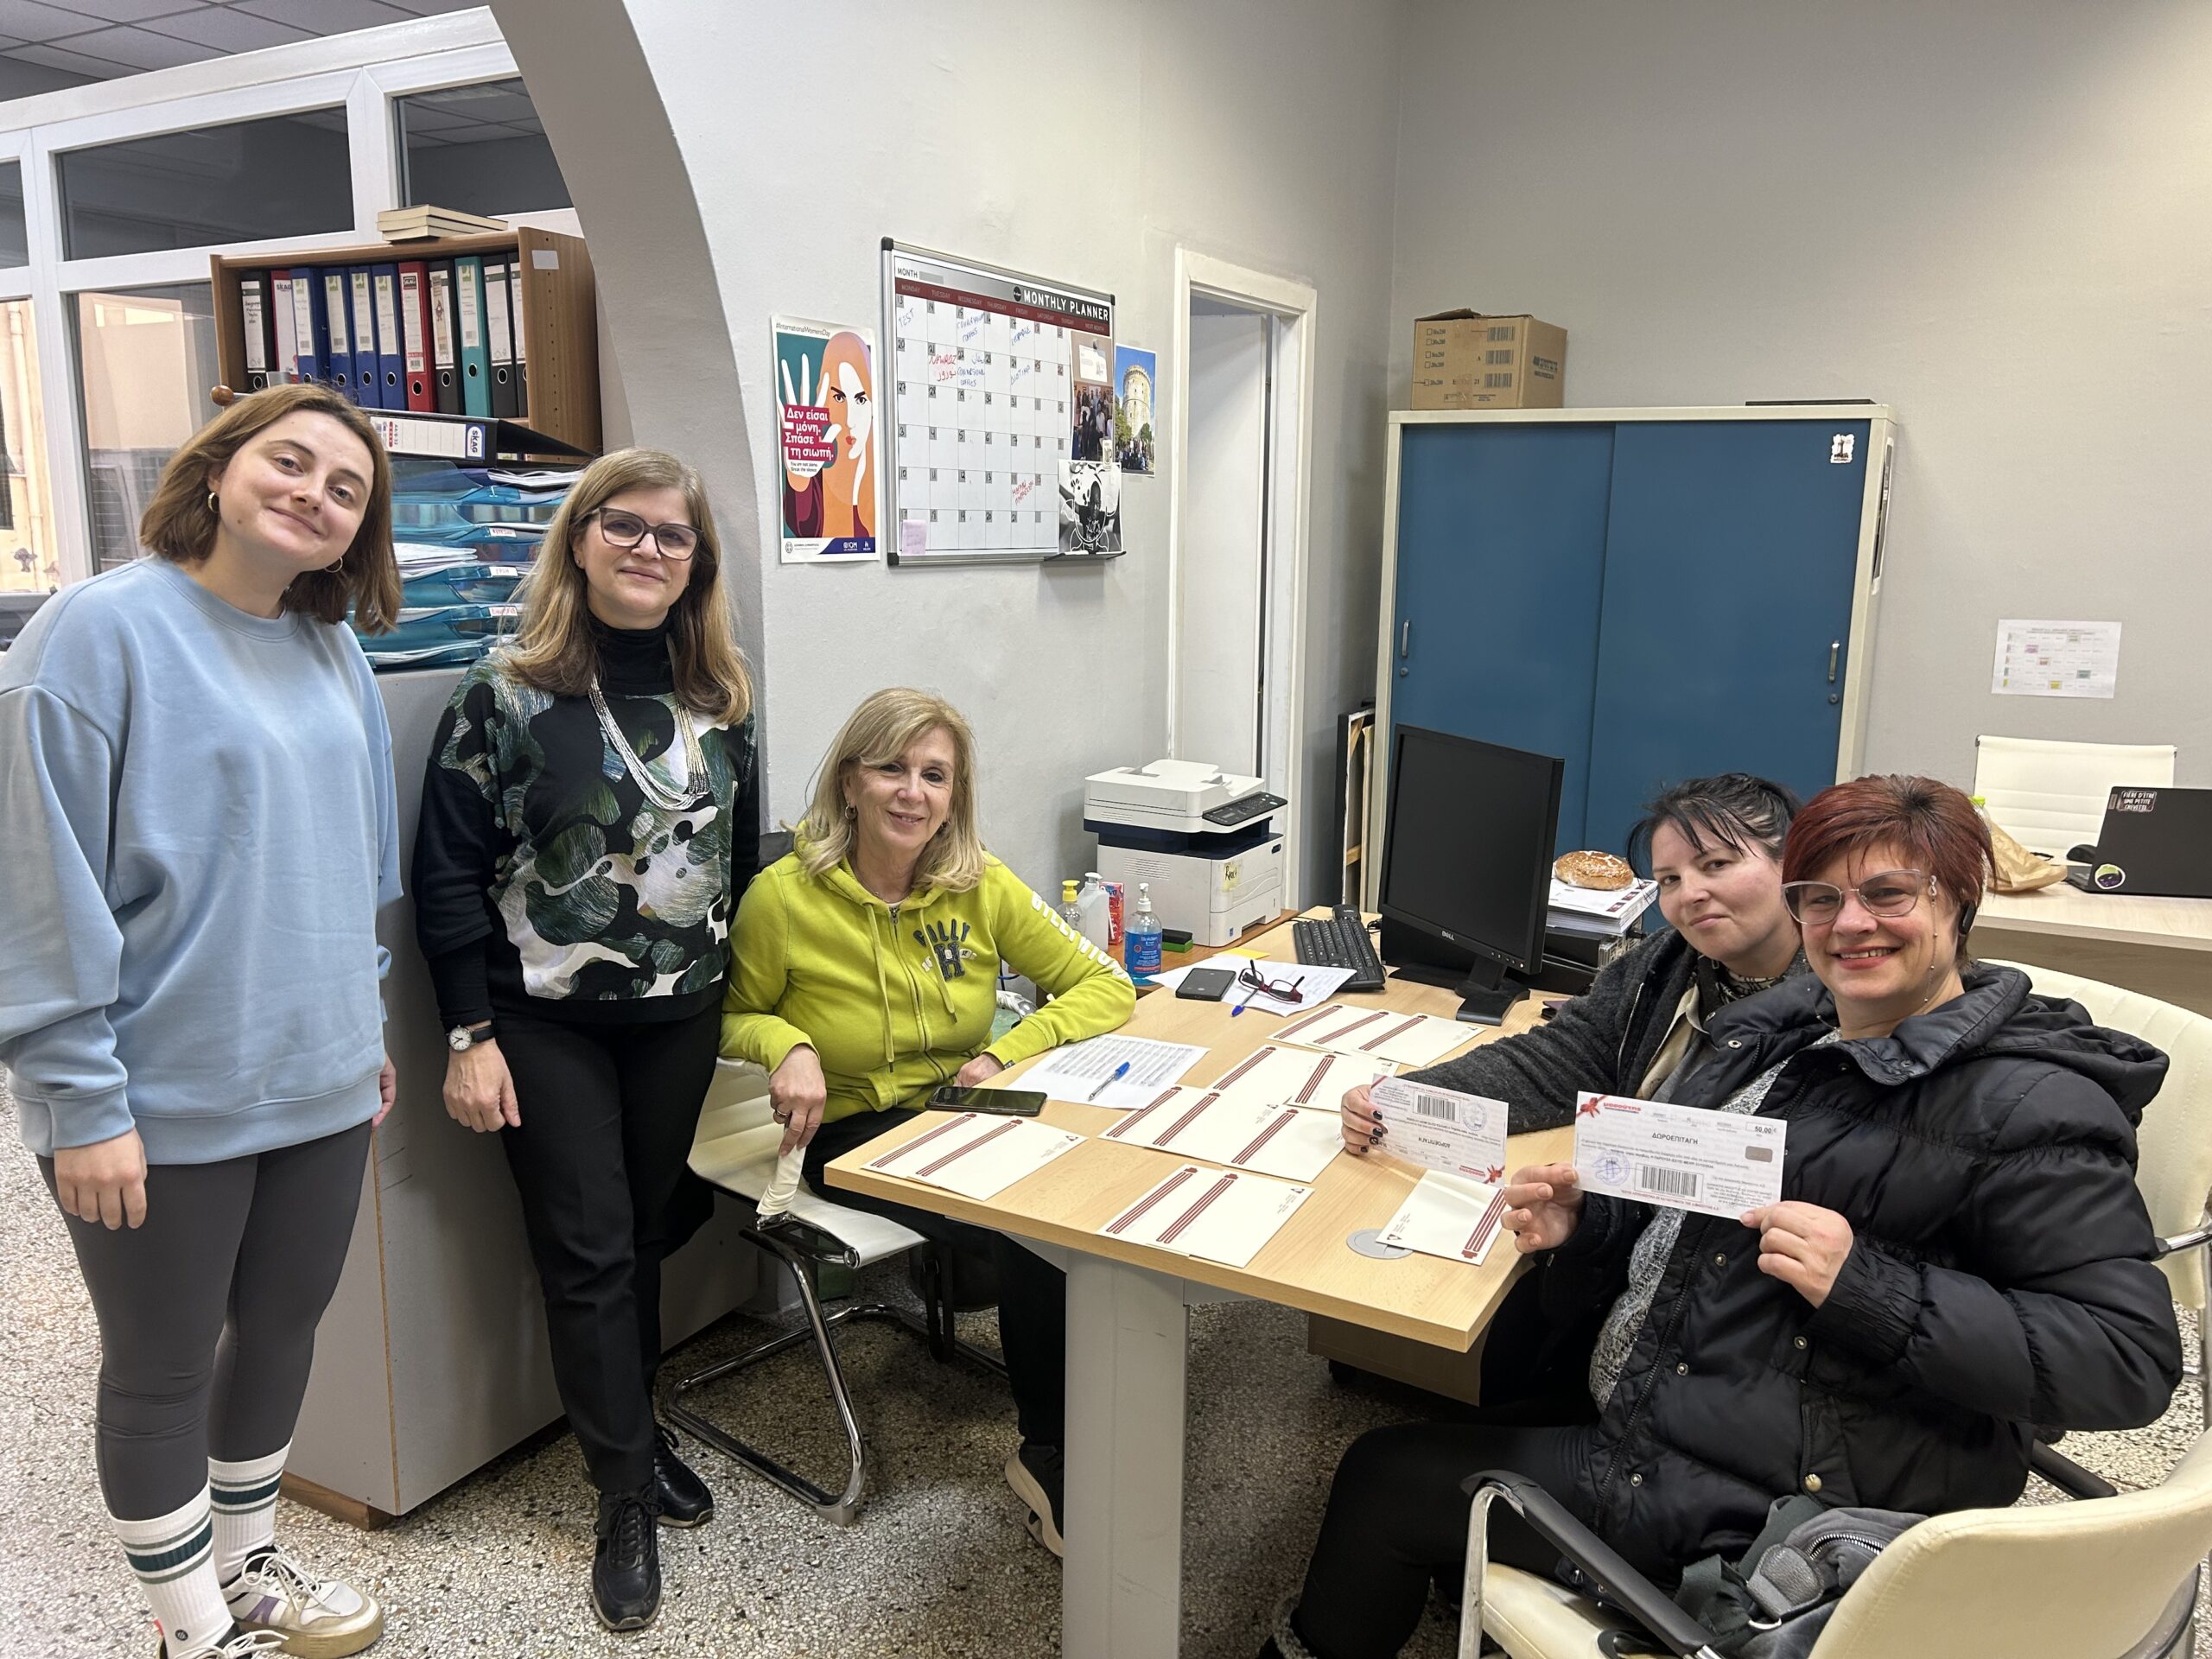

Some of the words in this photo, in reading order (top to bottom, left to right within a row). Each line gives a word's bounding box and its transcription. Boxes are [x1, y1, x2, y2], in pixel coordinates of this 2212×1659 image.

[897, 268, 918, 278] MONTH
[901, 284, 920, 293] MONDAY
[931, 289, 950, 298] TUESDAY
[957, 296, 982, 305] WEDNESDAY
[987, 301, 1007, 310] THURSDAY
[1037, 312, 1054, 321] SATURDAY
[1024, 289, 1067, 311] MONTHLY
[1070, 301, 1109, 321] PLANNER
[787, 408, 804, 419] Δεν
[806, 410, 828, 421] είσαι
[796, 421, 821, 435] μόνη.
[472, 429, 480, 453] SKAG
[785, 432, 814, 444] Σπάσε
[899, 426, 905, 436] 3
[931, 429, 935, 438] 4
[959, 430, 963, 439] 5
[986, 433, 990, 442] 6
[1012, 435, 1017, 445] 7
[791, 448, 801, 459] τη
[803, 447, 834, 461] σιωπή.
[900, 469, 906, 479] 10
[931, 470, 937, 480] 11
[986, 473, 992, 481] 13
[1441, 930, 1455, 941] DELL
[1651, 1132, 1699, 1145] ΔΩΡΟΕΠΙΤΑΓΗ
